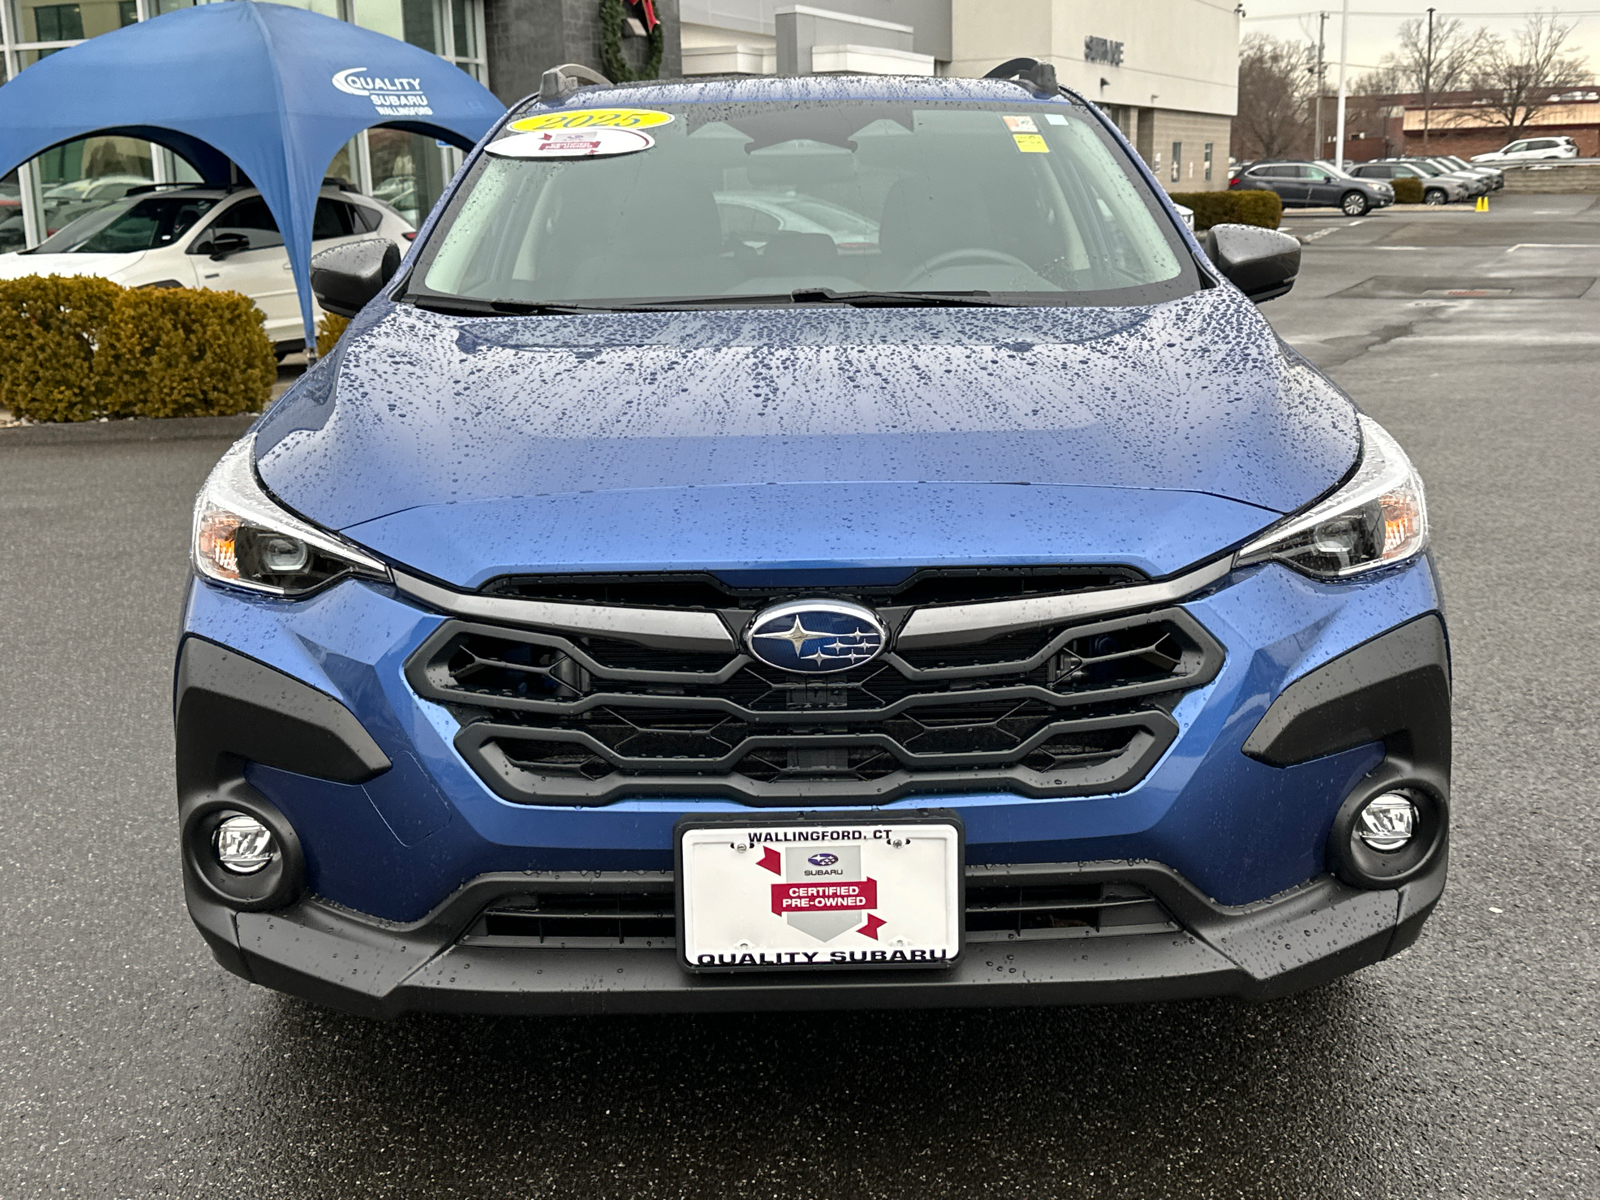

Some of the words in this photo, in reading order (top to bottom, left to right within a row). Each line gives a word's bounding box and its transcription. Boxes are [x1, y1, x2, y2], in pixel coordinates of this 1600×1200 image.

[347, 76, 420, 90] QUALITY
[370, 95, 429, 106] SUBARU
[532, 113, 650, 130] 2025
[873, 830, 892, 840] CT
[789, 886, 859, 897] CERTIFIED
[782, 896, 866, 908] PRE-OWNED
[697, 951, 819, 965] QUALITY
[830, 949, 947, 962] SUBARU
